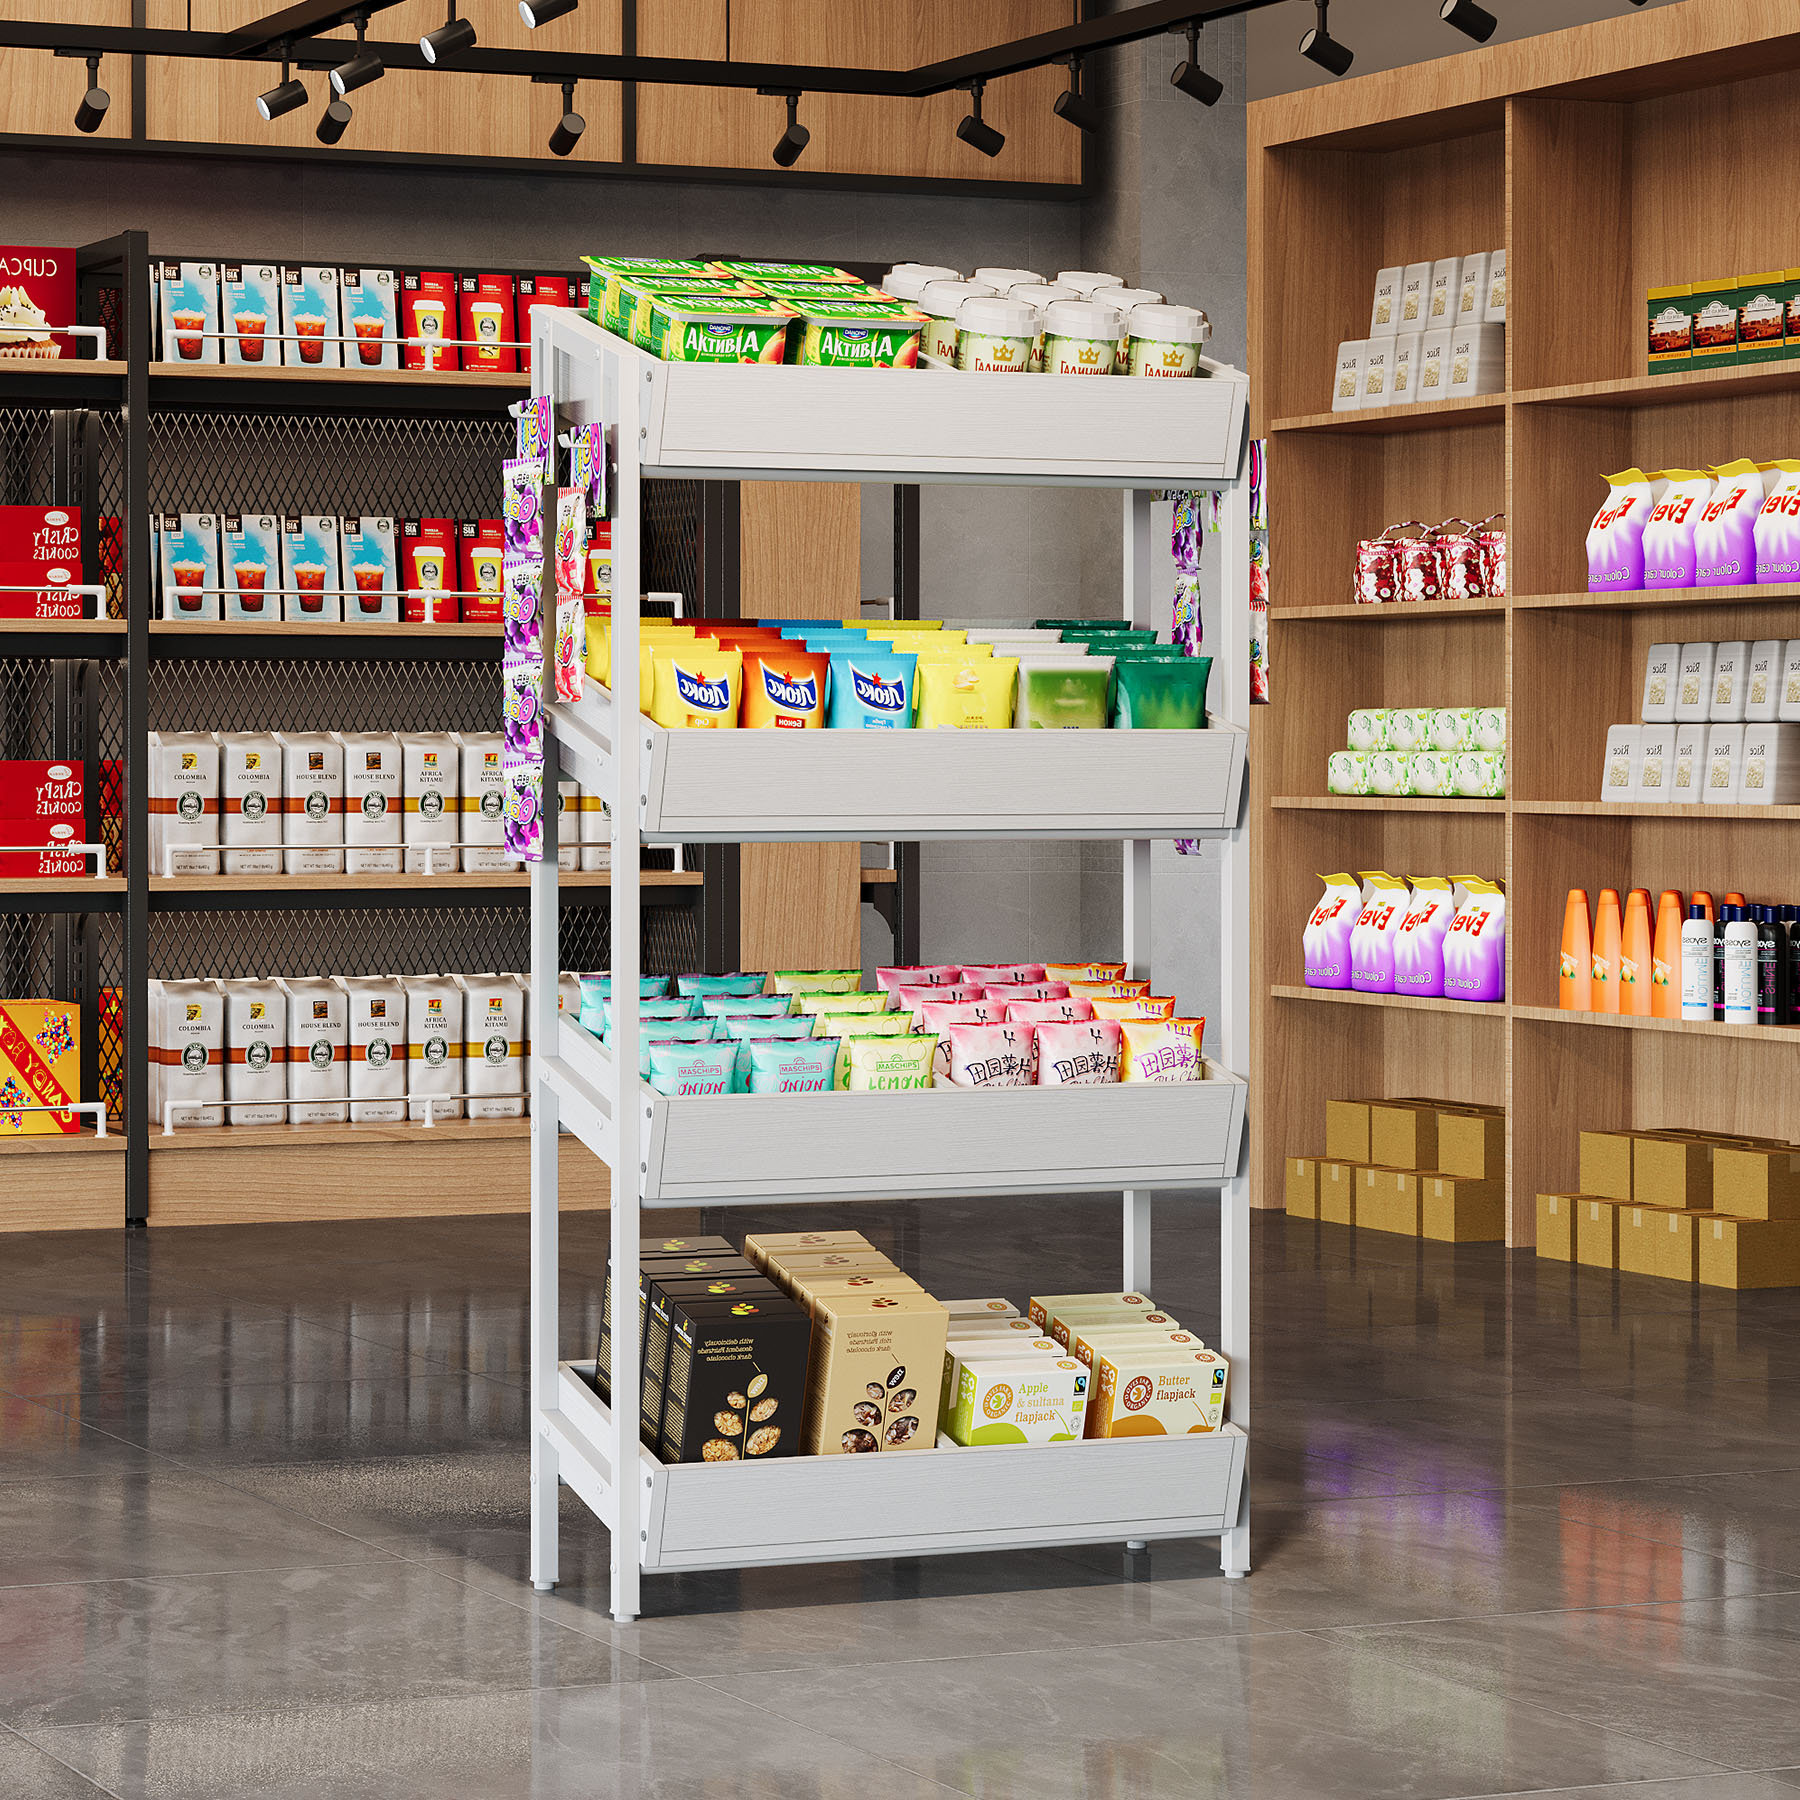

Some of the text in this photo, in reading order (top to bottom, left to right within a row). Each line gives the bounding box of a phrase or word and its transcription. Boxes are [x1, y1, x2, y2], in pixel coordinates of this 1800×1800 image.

[685, 327, 760, 353] АКТИВІА
[821, 332, 893, 358] АКТИВІА
[680, 1067, 720, 1075] MASCHIPS
[781, 1065, 820, 1073] MASCHIPS
[878, 1062, 917, 1070] MASCHIPS
[1158, 1375, 1190, 1386] Butter
[1018, 1382, 1048, 1396] Apple
[1156, 1388, 1197, 1402] flapjack
[1016, 1396, 1064, 1408] & sultana
[1015, 1409, 1057, 1425] flapjack
